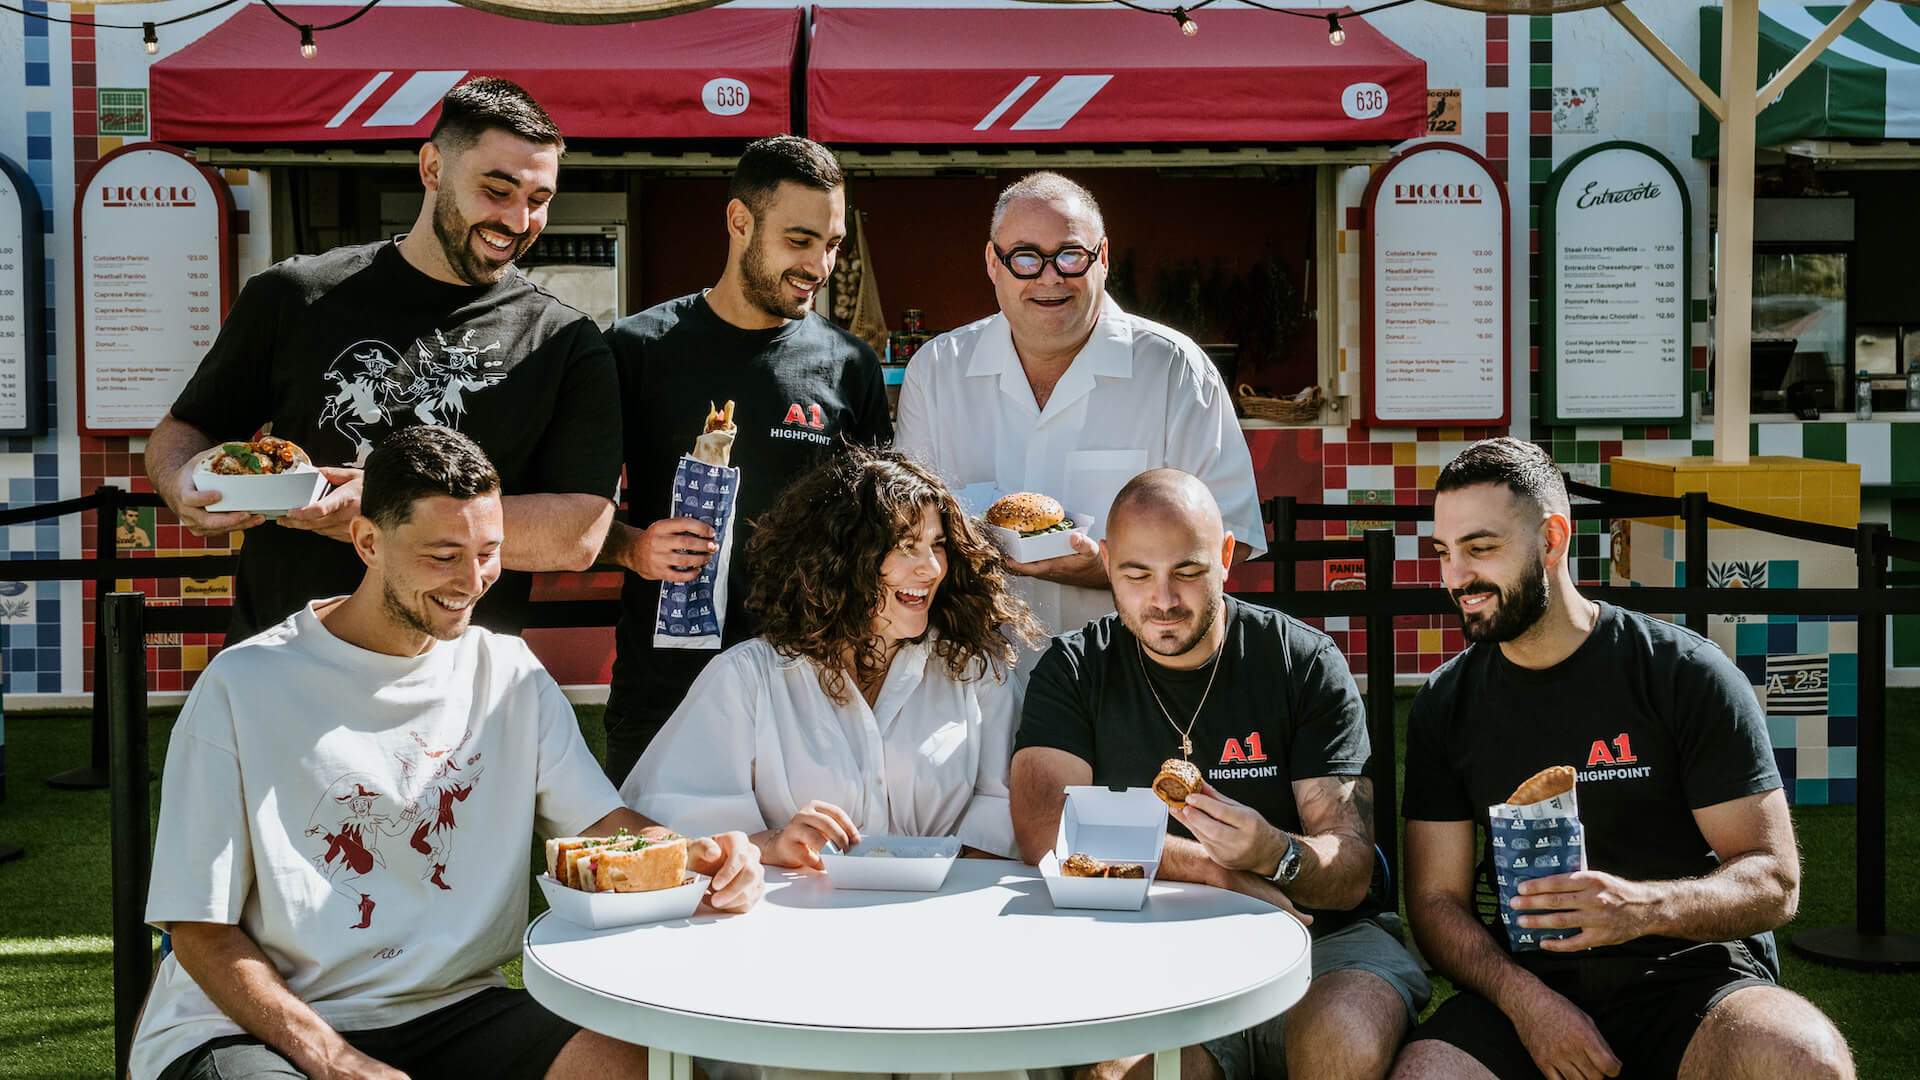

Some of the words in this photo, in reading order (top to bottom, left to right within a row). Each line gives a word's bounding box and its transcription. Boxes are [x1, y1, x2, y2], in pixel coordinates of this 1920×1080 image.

[718, 86, 744, 106] 636
[1356, 90, 1382, 111] 636
[1427, 120, 1456, 131] 122
[102, 186, 196, 200] PICCOLO
[1395, 184, 1482, 198] PICCOLO
[1577, 181, 1661, 209] Entrecôte
[782, 403, 825, 430] A1
[770, 428, 831, 445] HIGHPOINT
[1330, 564, 1363, 573] PANIN
[1794, 670, 1822, 690] 25
[1219, 732, 1267, 765] A1
[1586, 733, 1637, 768] A1
[1209, 766, 1277, 779] HIGHPOINT
[1576, 766, 1650, 782] HIGHPOINT
